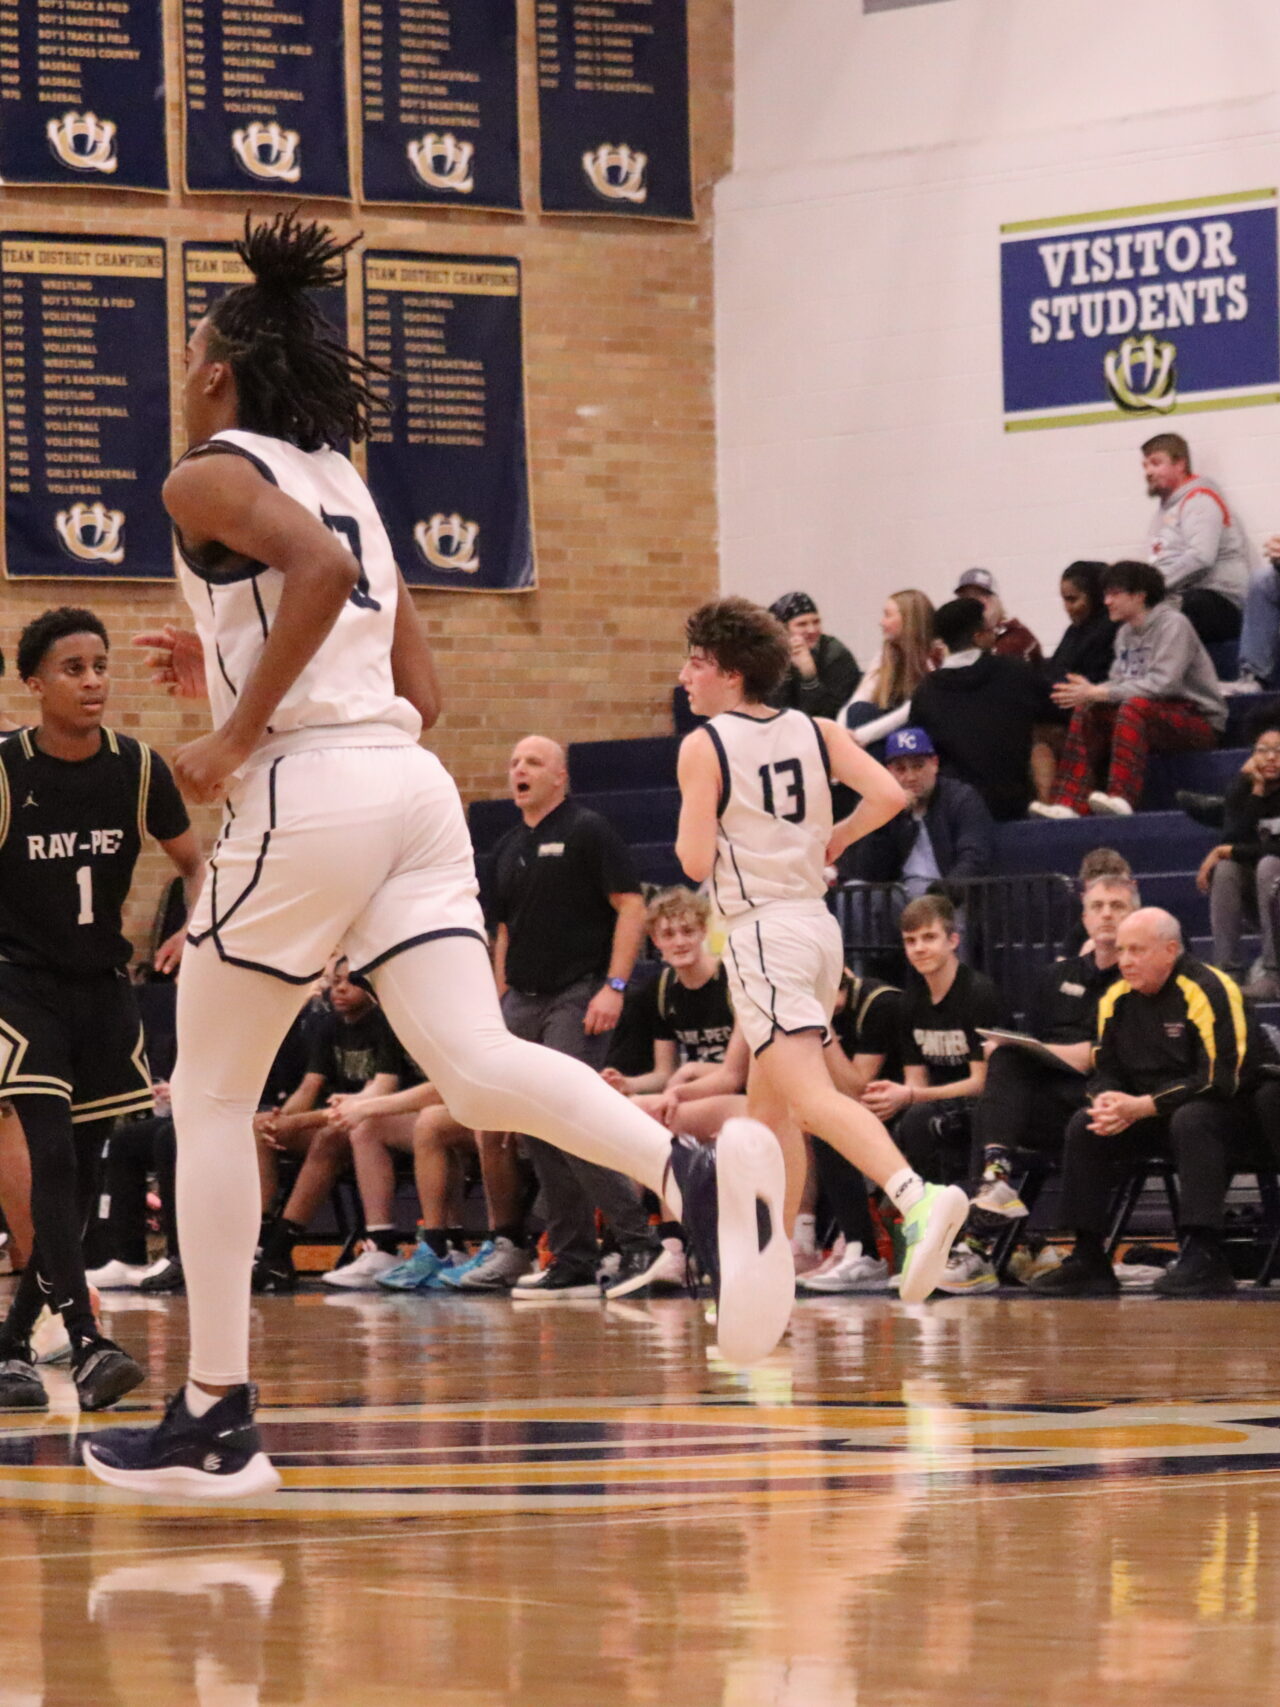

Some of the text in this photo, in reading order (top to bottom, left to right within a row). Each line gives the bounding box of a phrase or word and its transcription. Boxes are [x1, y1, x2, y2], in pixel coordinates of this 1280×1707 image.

[3, 249, 162, 269] TEAM DISTRICT CHAMPIONS
[187, 260, 217, 274] TEAM
[1038, 220, 1237, 288] VISITOR
[1029, 273, 1249, 344] STUDENTS
[896, 731, 917, 750] KC
[758, 757, 807, 825] 13
[75, 865, 95, 926] 1
